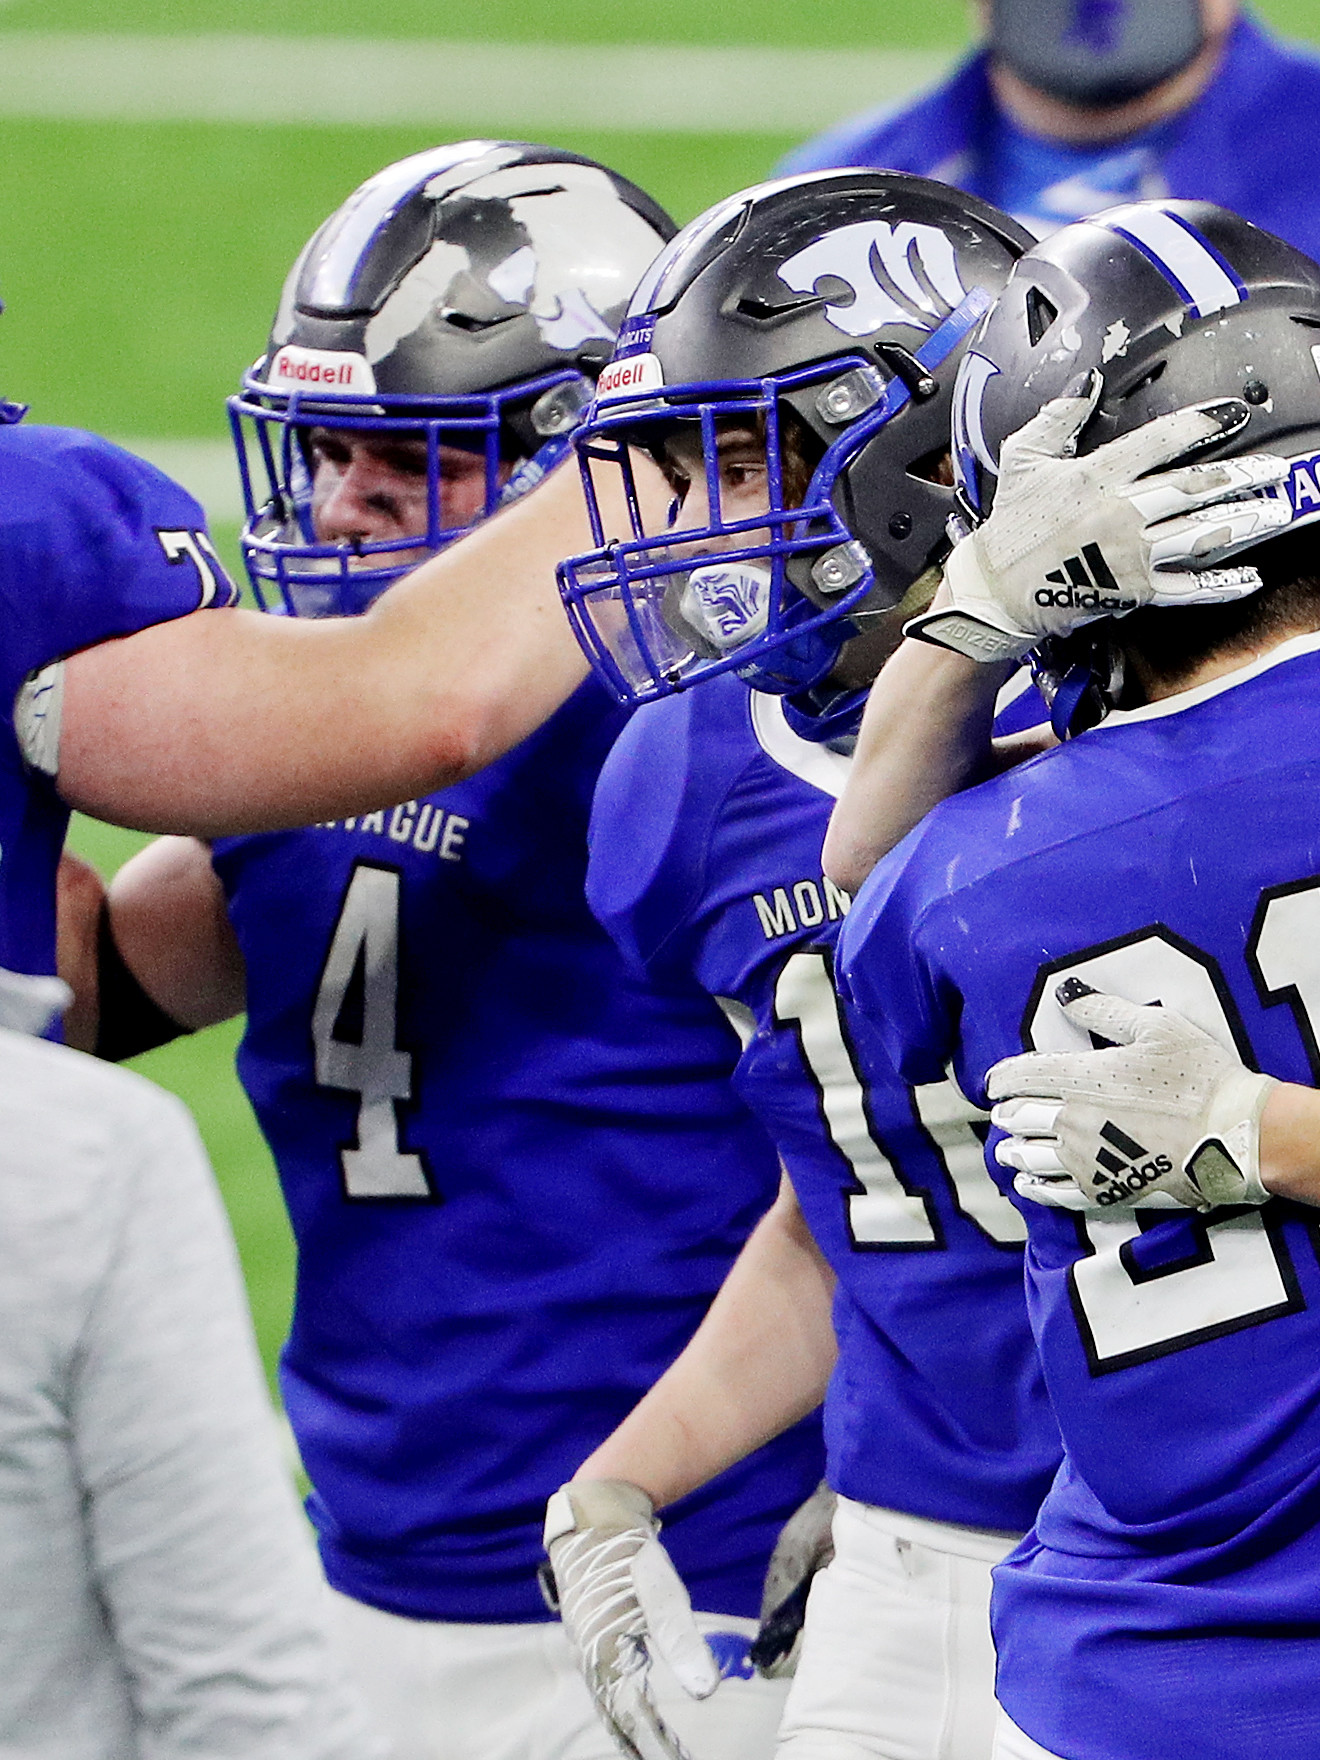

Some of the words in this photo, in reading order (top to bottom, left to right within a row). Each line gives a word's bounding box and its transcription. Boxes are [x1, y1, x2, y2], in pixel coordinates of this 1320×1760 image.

[279, 357, 352, 384] Riddell
[1035, 585, 1138, 609] adidas
[310, 864, 431, 1199] 4
[1096, 1154, 1173, 1206] adidas
